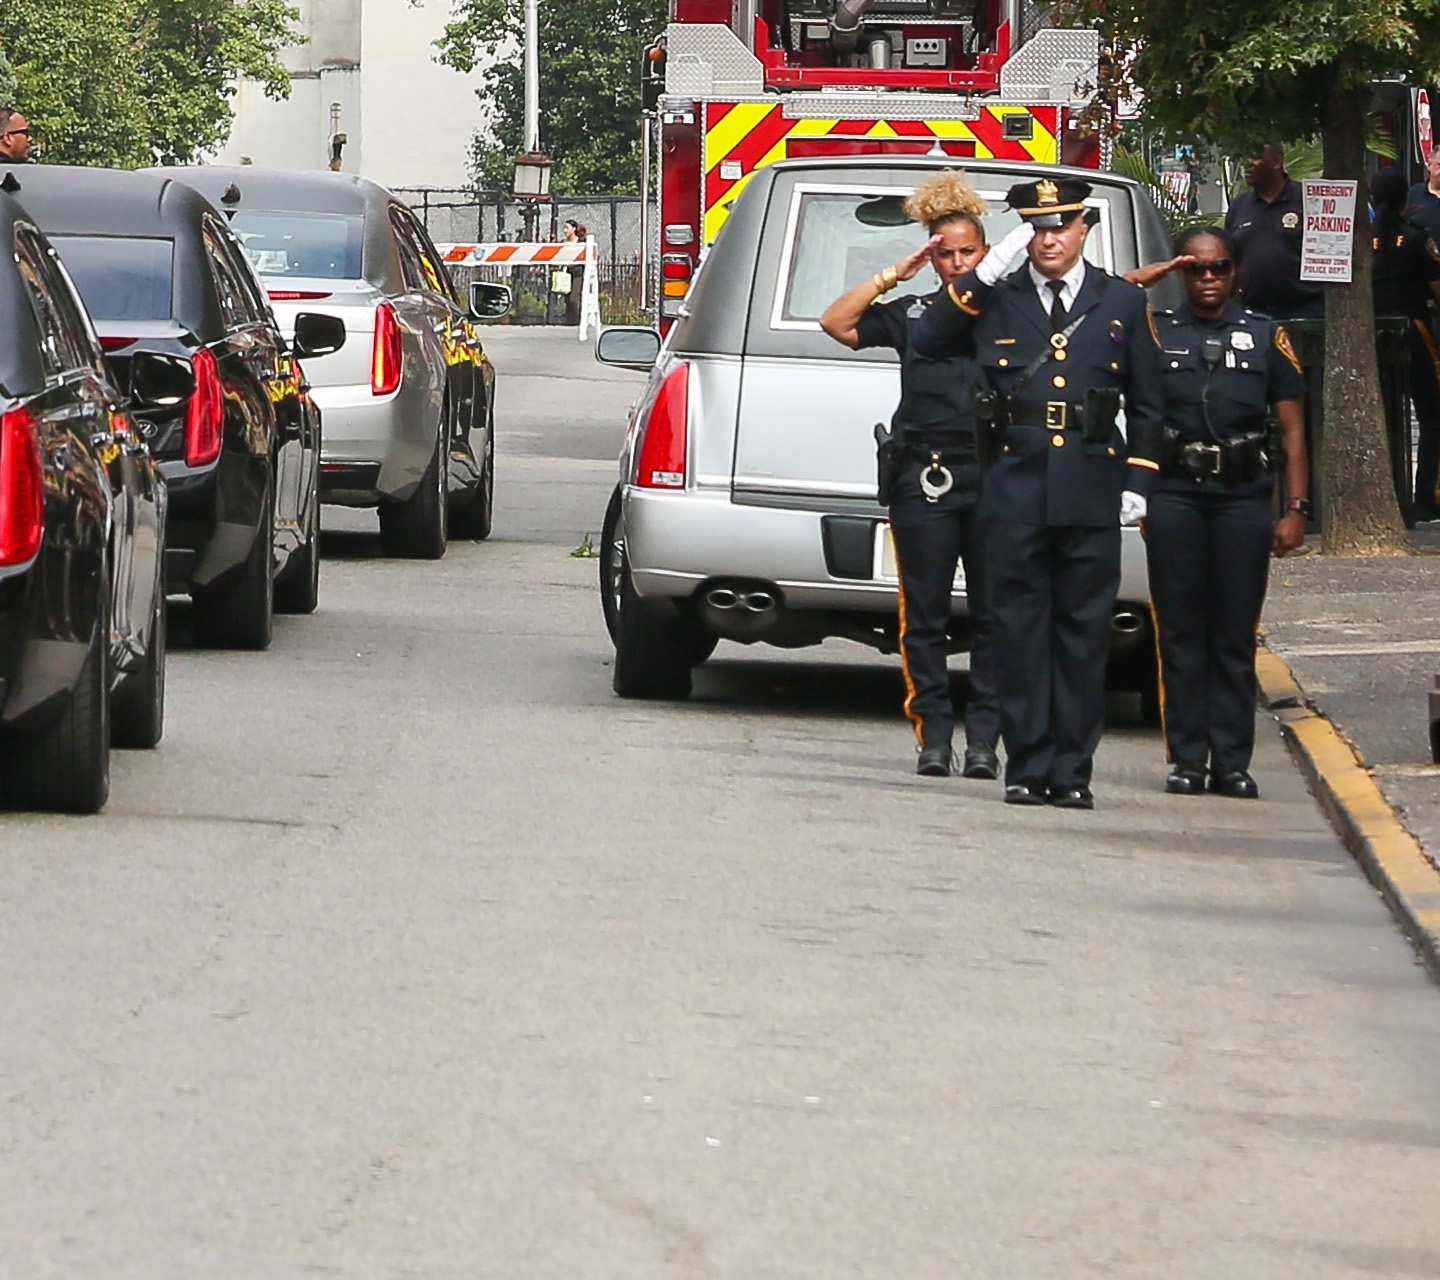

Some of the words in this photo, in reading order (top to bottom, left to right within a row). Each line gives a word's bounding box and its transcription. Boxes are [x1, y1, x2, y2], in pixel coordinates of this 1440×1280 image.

[1307, 185, 1354, 197] EMERGENCY
[1322, 199, 1336, 215] NO
[1307, 216, 1351, 233] PARKING
